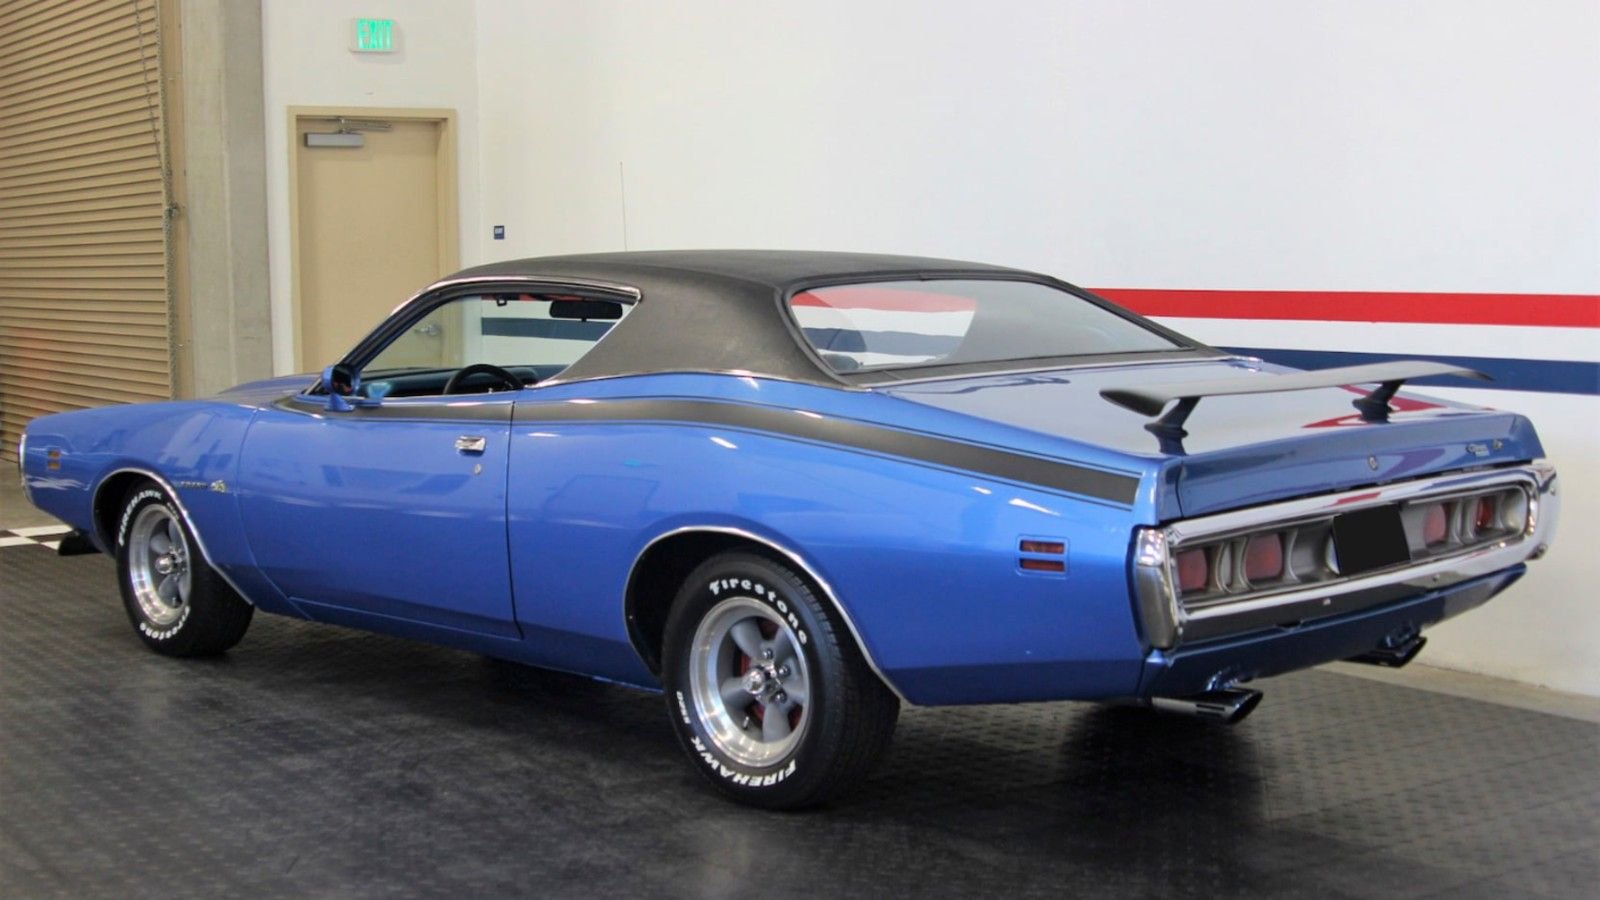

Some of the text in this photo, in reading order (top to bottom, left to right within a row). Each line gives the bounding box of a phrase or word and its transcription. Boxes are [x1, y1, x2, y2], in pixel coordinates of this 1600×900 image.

[357, 18, 392, 49] EXIT
[118, 489, 162, 547] FIREHAWK
[709, 578, 807, 645] Firestone
[690, 736, 797, 787] FIREHAWK
